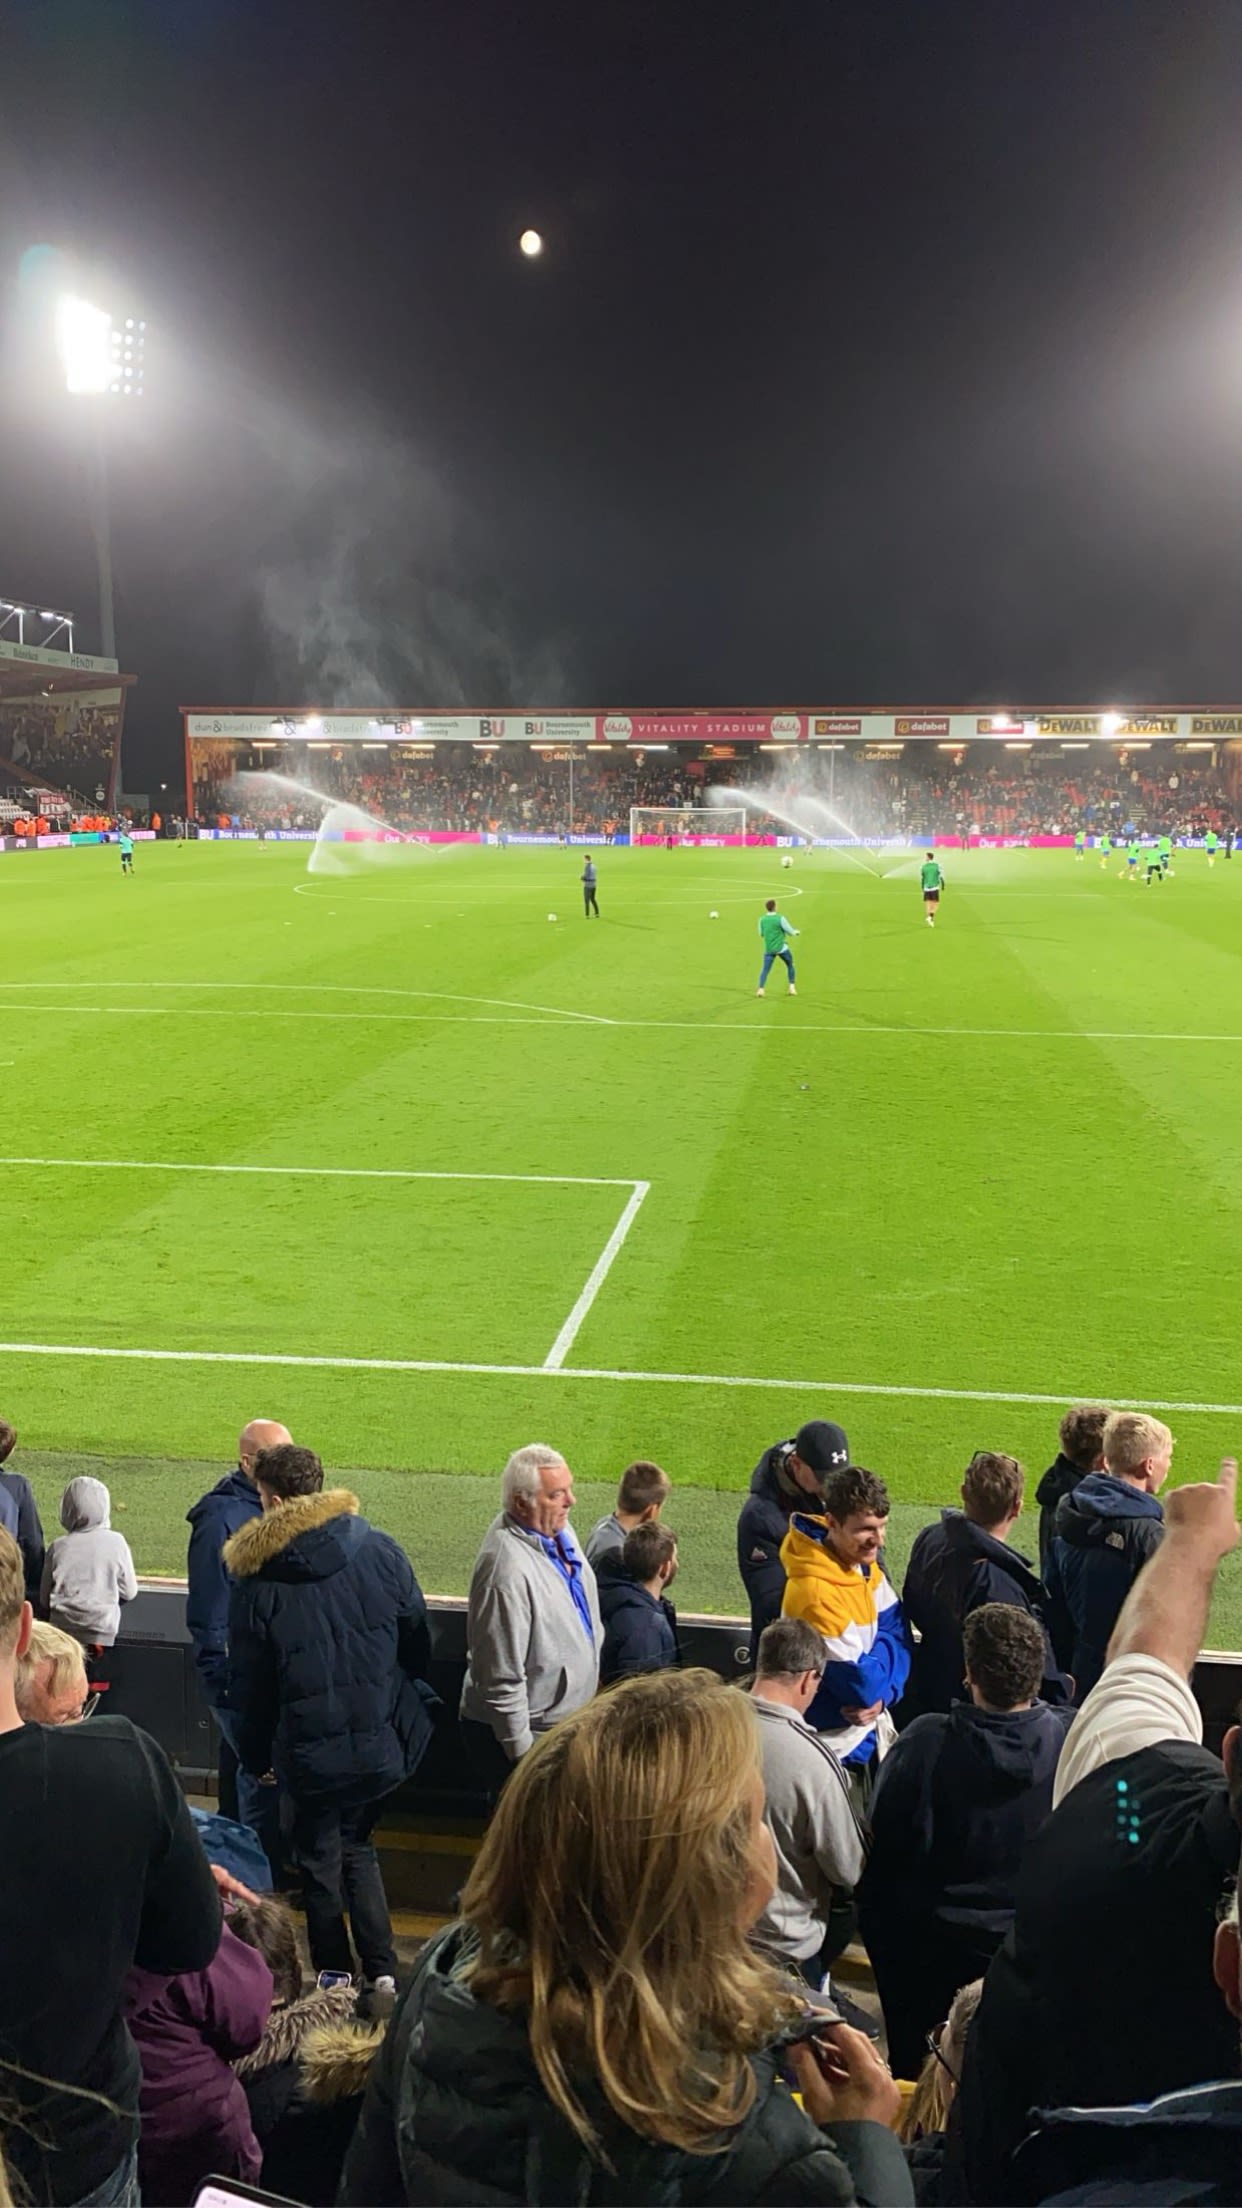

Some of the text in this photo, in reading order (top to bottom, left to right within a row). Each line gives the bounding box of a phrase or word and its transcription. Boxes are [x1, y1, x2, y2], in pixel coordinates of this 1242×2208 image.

[480, 719, 504, 738] BU
[525, 721, 543, 735] BU
[638, 724, 766, 732] VITALITY STADIUM
[829, 722, 859, 732] dafabet
[911, 721, 947, 732] dafabet
[1122, 718, 1176, 732] EWALT
[402, 751, 434, 760] dafabet
[865, 752, 901, 761] dafabet
[219, 830, 276, 840] Bournemuth
[508, 834, 567, 844] Bournemou
[570, 834, 615, 845] Universiy
